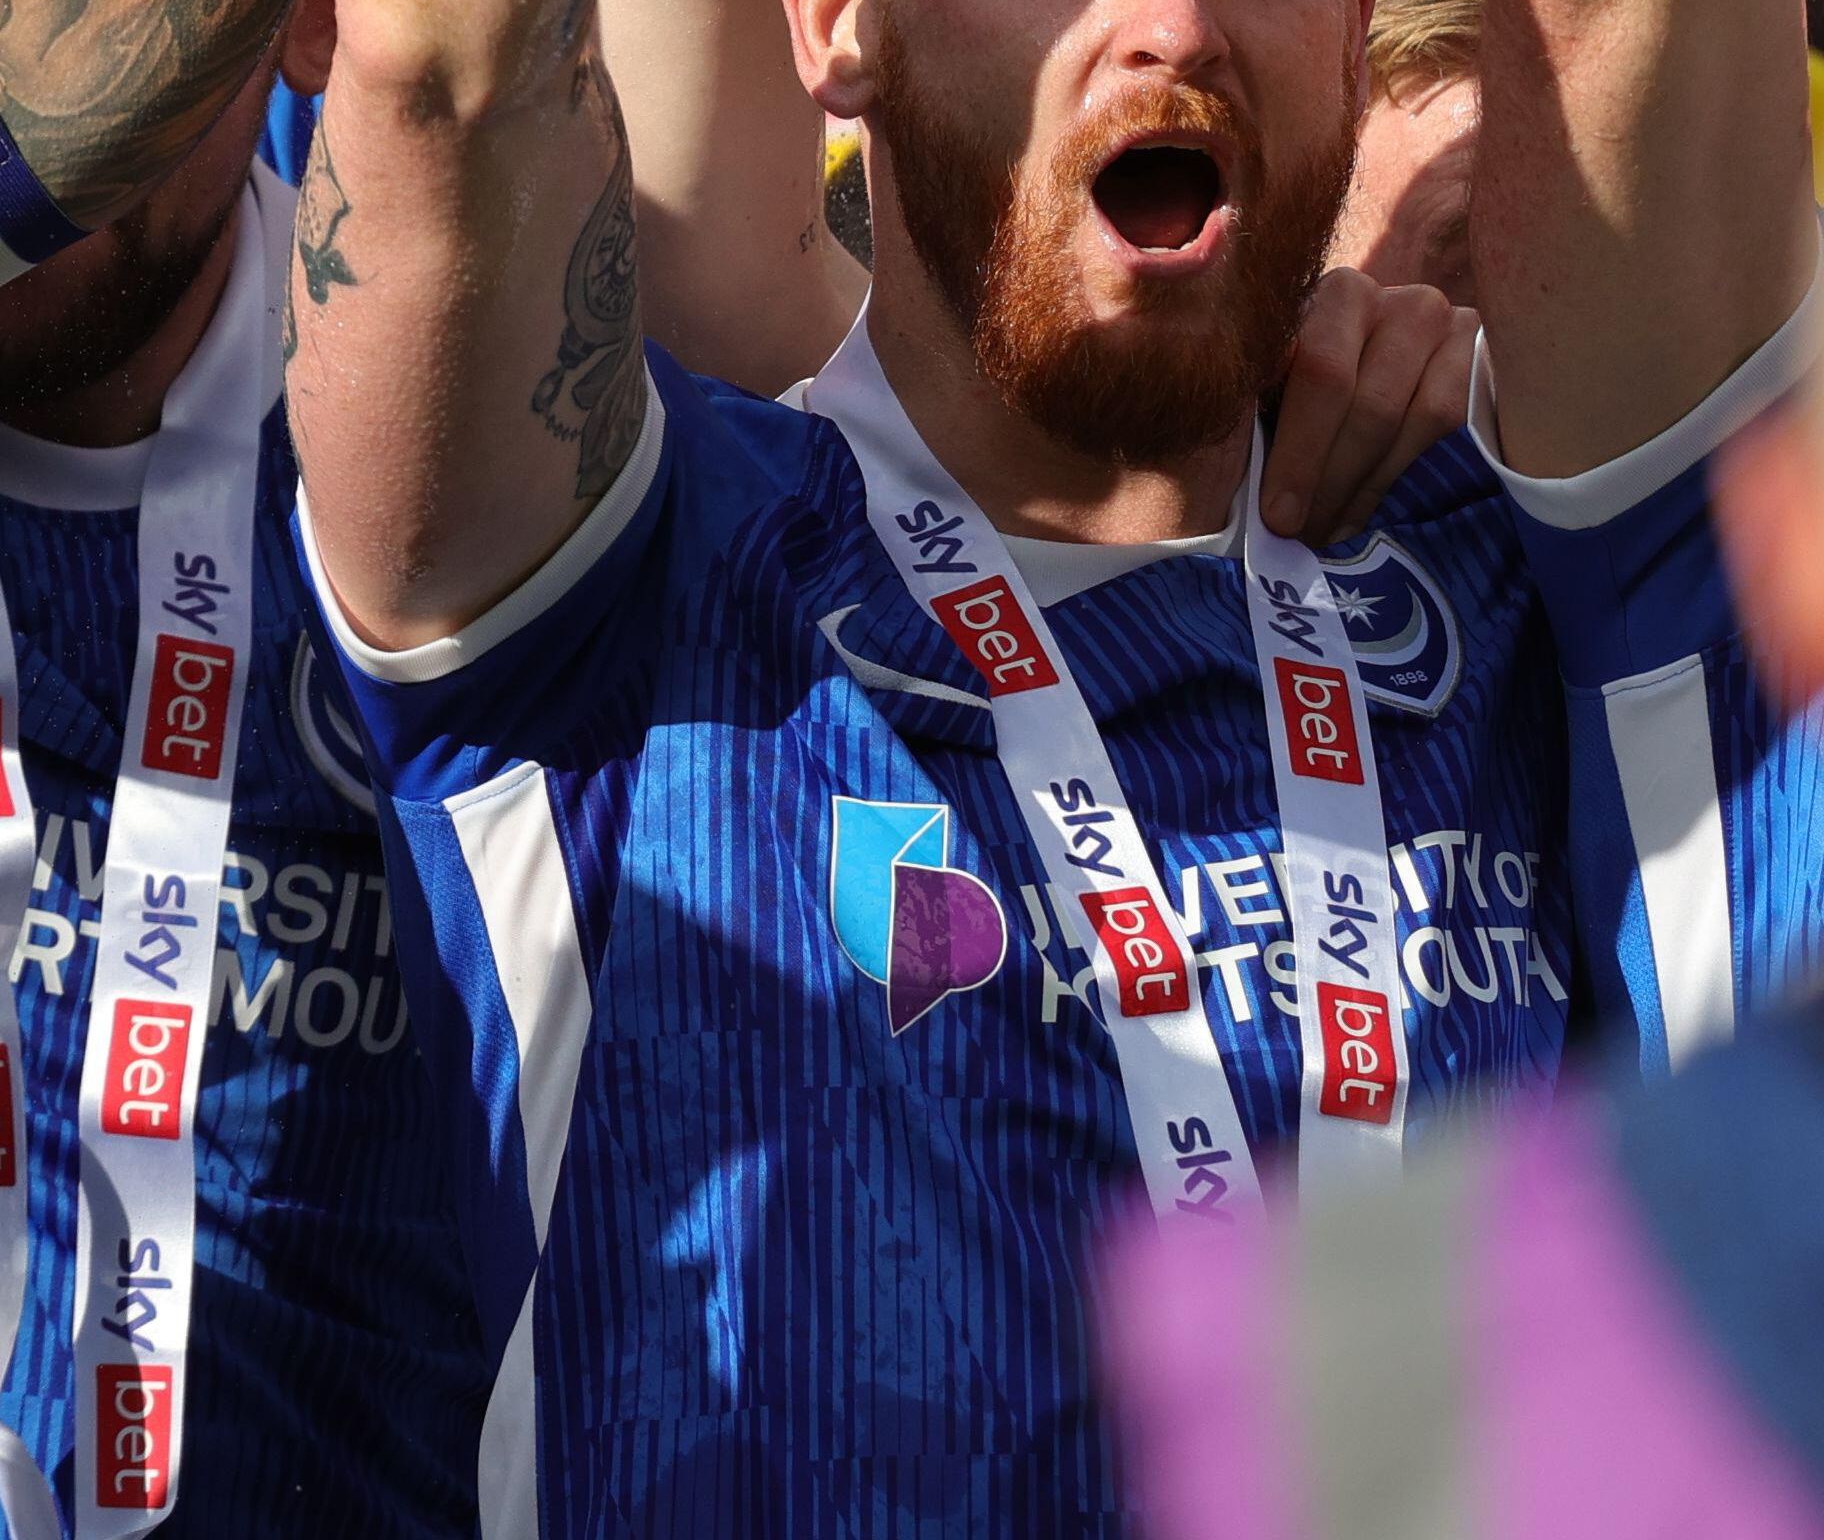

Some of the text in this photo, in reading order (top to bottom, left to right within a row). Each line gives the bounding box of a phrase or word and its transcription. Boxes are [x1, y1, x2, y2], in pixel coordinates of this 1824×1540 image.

[160, 551, 231, 762] sky bet
[894, 498, 1041, 683] sky bet
[1259, 573, 1350, 772] sky bet
[1388, 667, 1429, 689] 1898
[1050, 777, 1177, 1002] sky bet
[1494, 851, 1541, 910] OF
[118, 872, 200, 1131] sky bet
[1317, 870, 1384, 1109] sky bet
[1166, 1116, 1236, 1230] sky
[101, 1235, 173, 1497] sky bet
